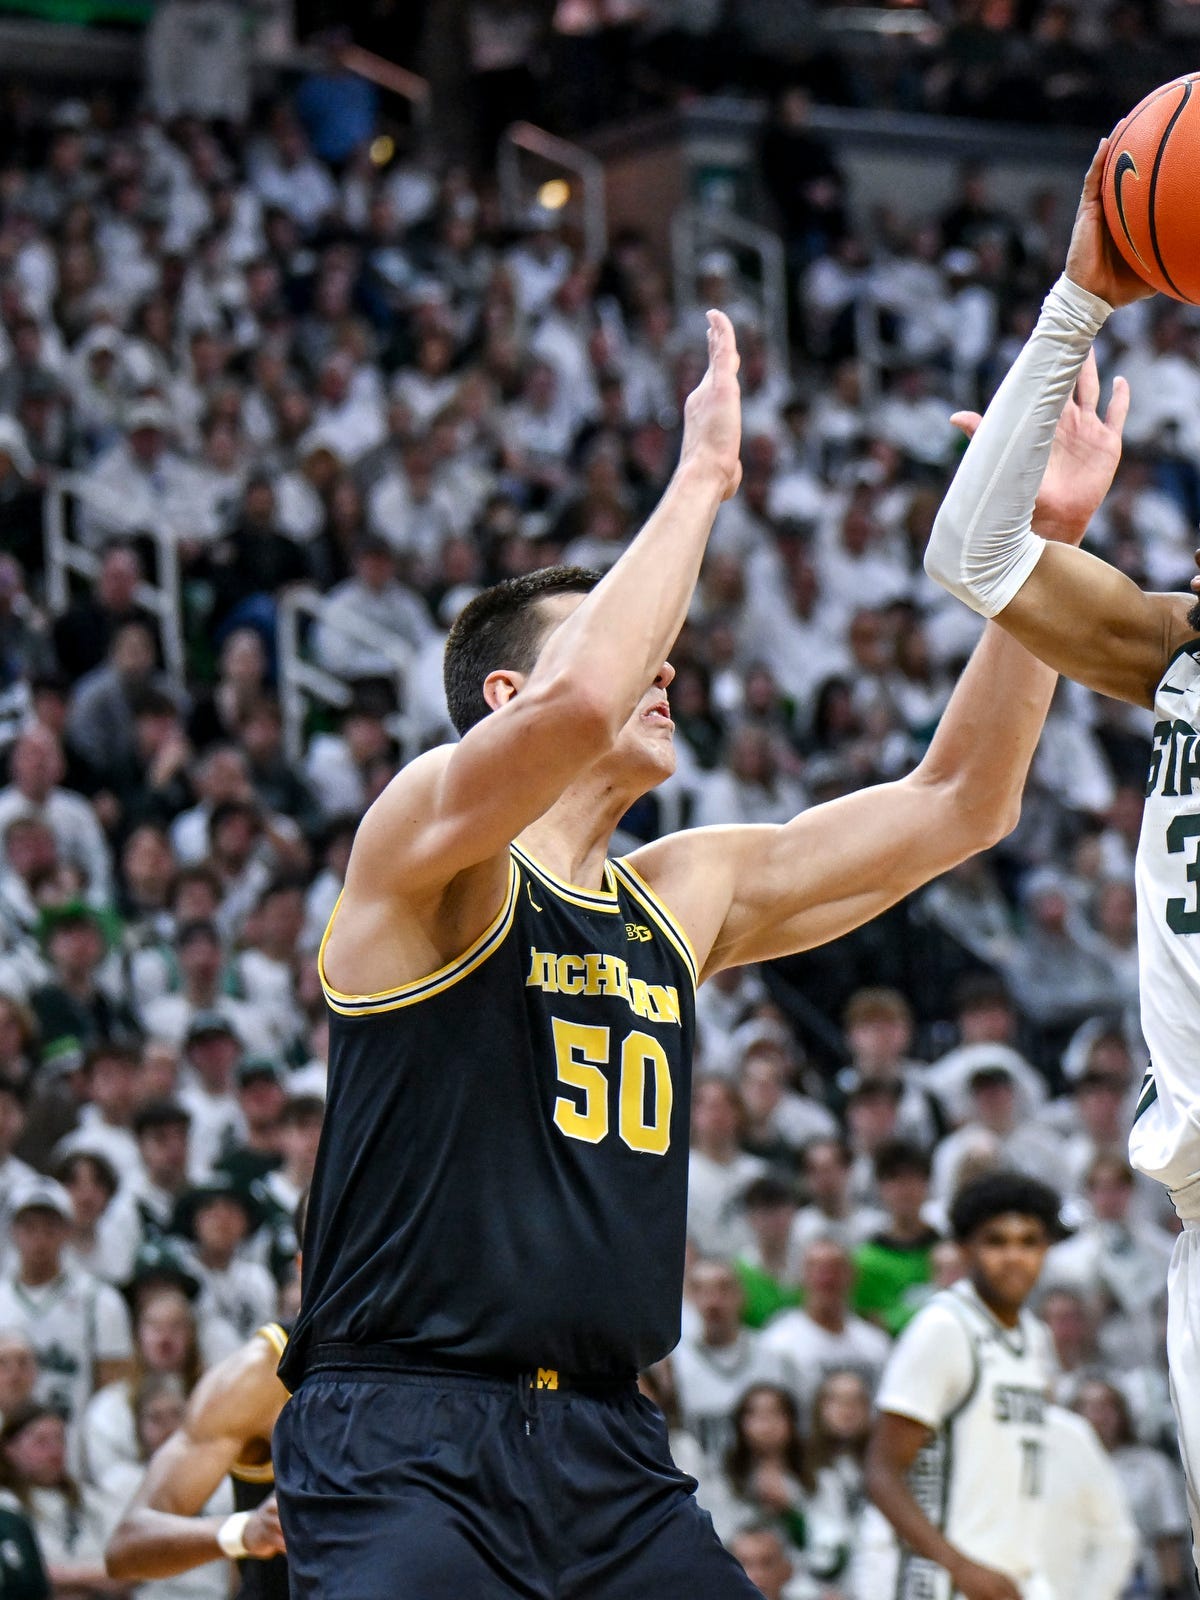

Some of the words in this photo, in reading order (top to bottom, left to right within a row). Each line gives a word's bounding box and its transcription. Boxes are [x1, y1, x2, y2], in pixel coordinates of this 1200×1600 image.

[625, 923, 653, 942] BG
[525, 946, 682, 1028] ICHAN
[551, 1016, 673, 1156] 50
[530, 1367, 559, 1390] M
